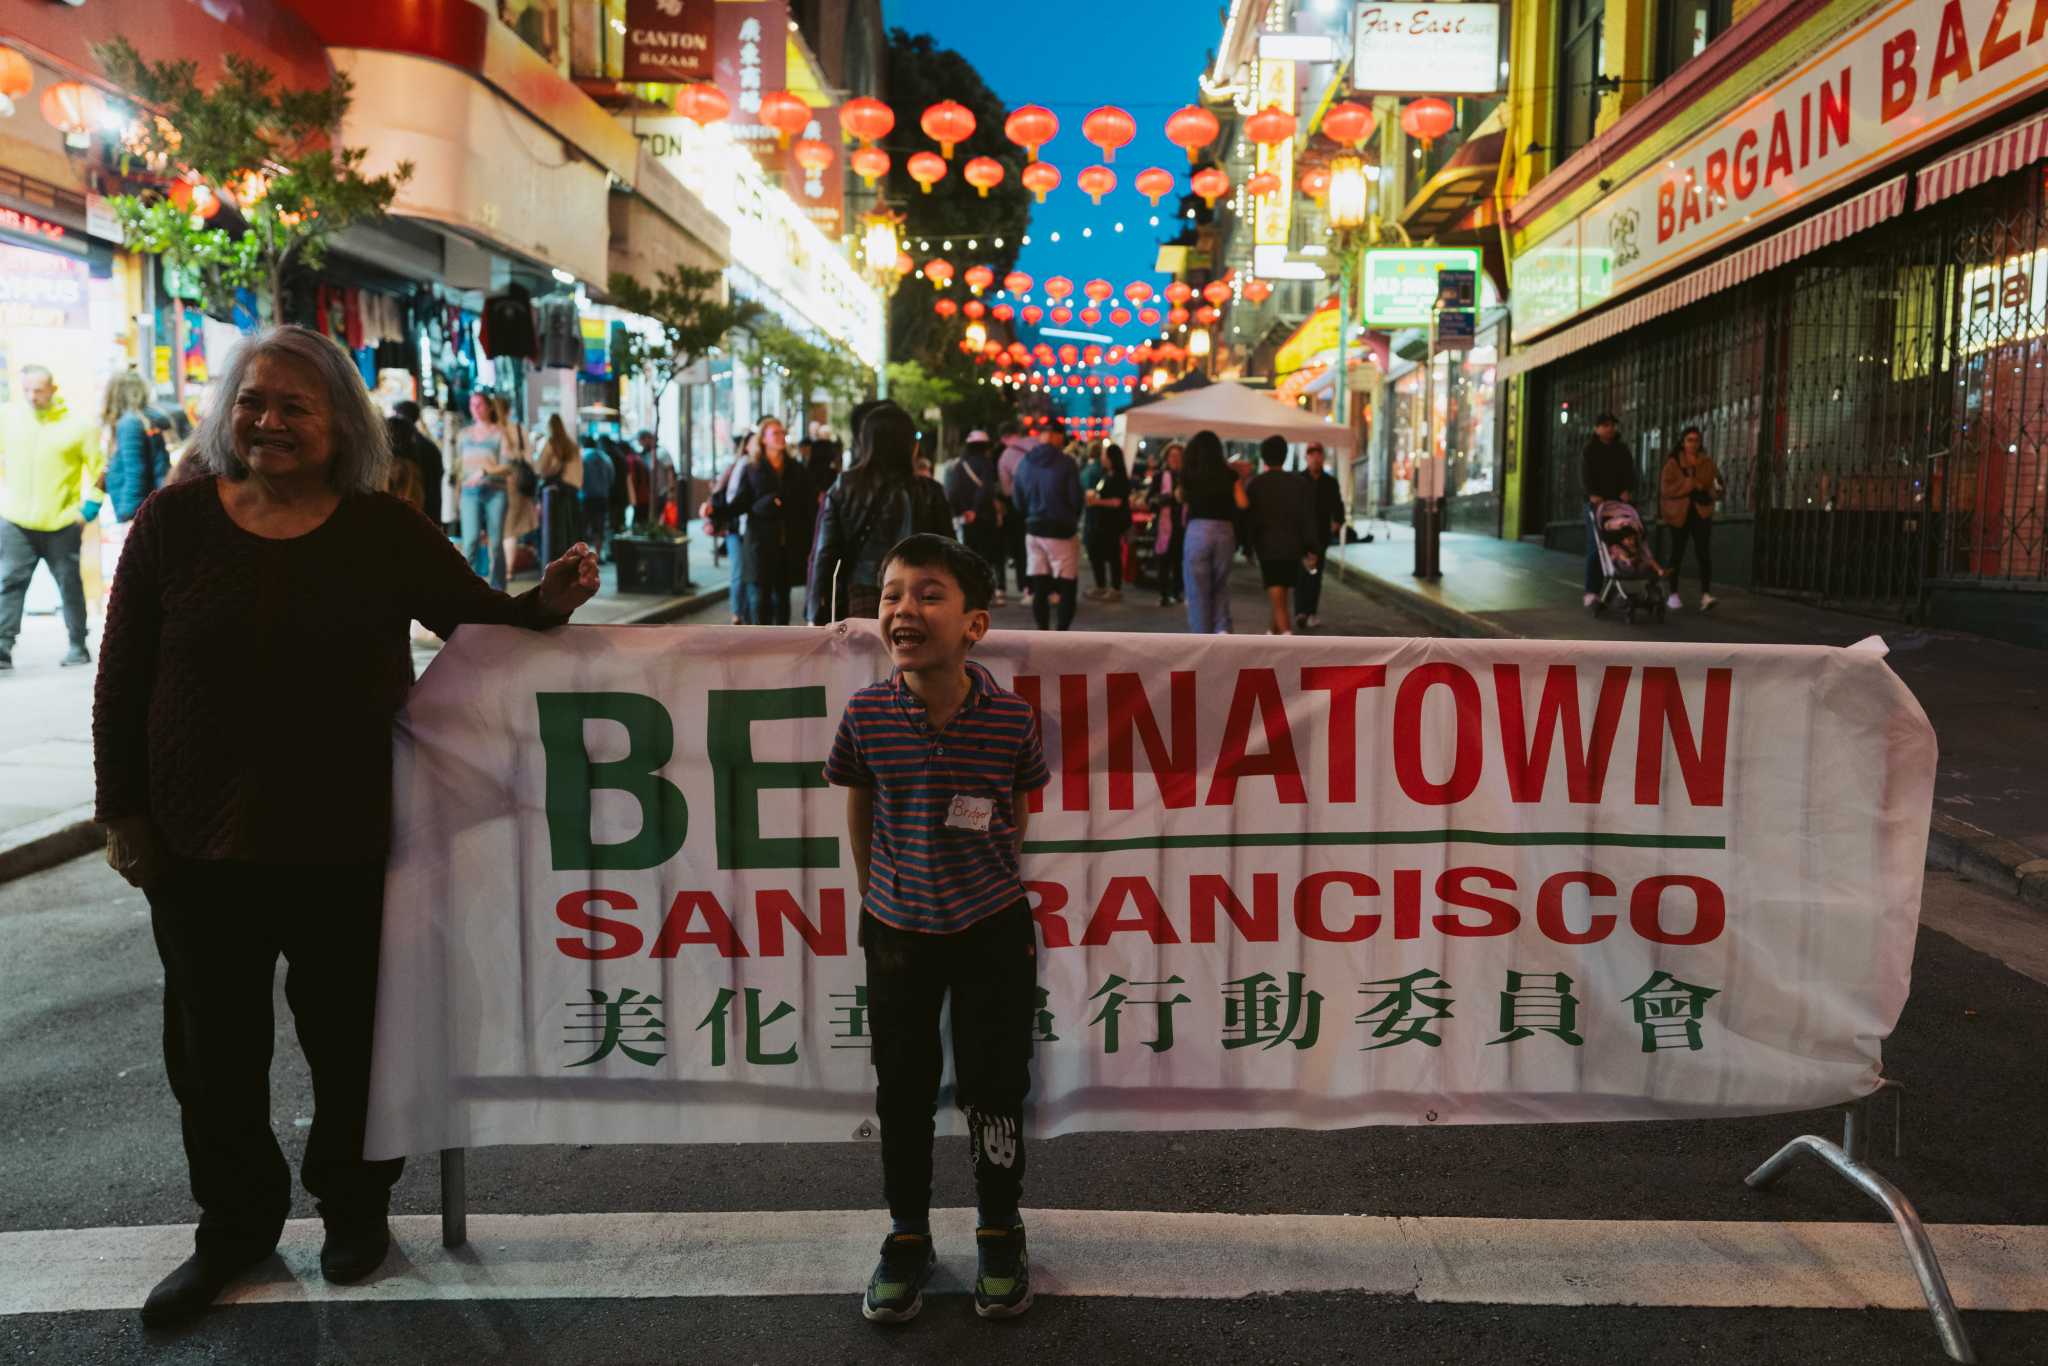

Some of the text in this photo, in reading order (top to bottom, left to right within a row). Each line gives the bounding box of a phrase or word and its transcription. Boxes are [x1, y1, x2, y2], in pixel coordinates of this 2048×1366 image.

[632, 30, 707, 50] CANTON
[639, 53, 699, 68] BAZAAR
[1361, 8, 1402, 35] Far
[1409, 10, 1465, 35] East
[1656, 67, 1851, 244] BARGAIN
[536, 661, 1732, 871] BE INATOWN
[555, 865, 1727, 960] SAN RANCISCO
[563, 970, 1722, 1068] 美化行動委員會
